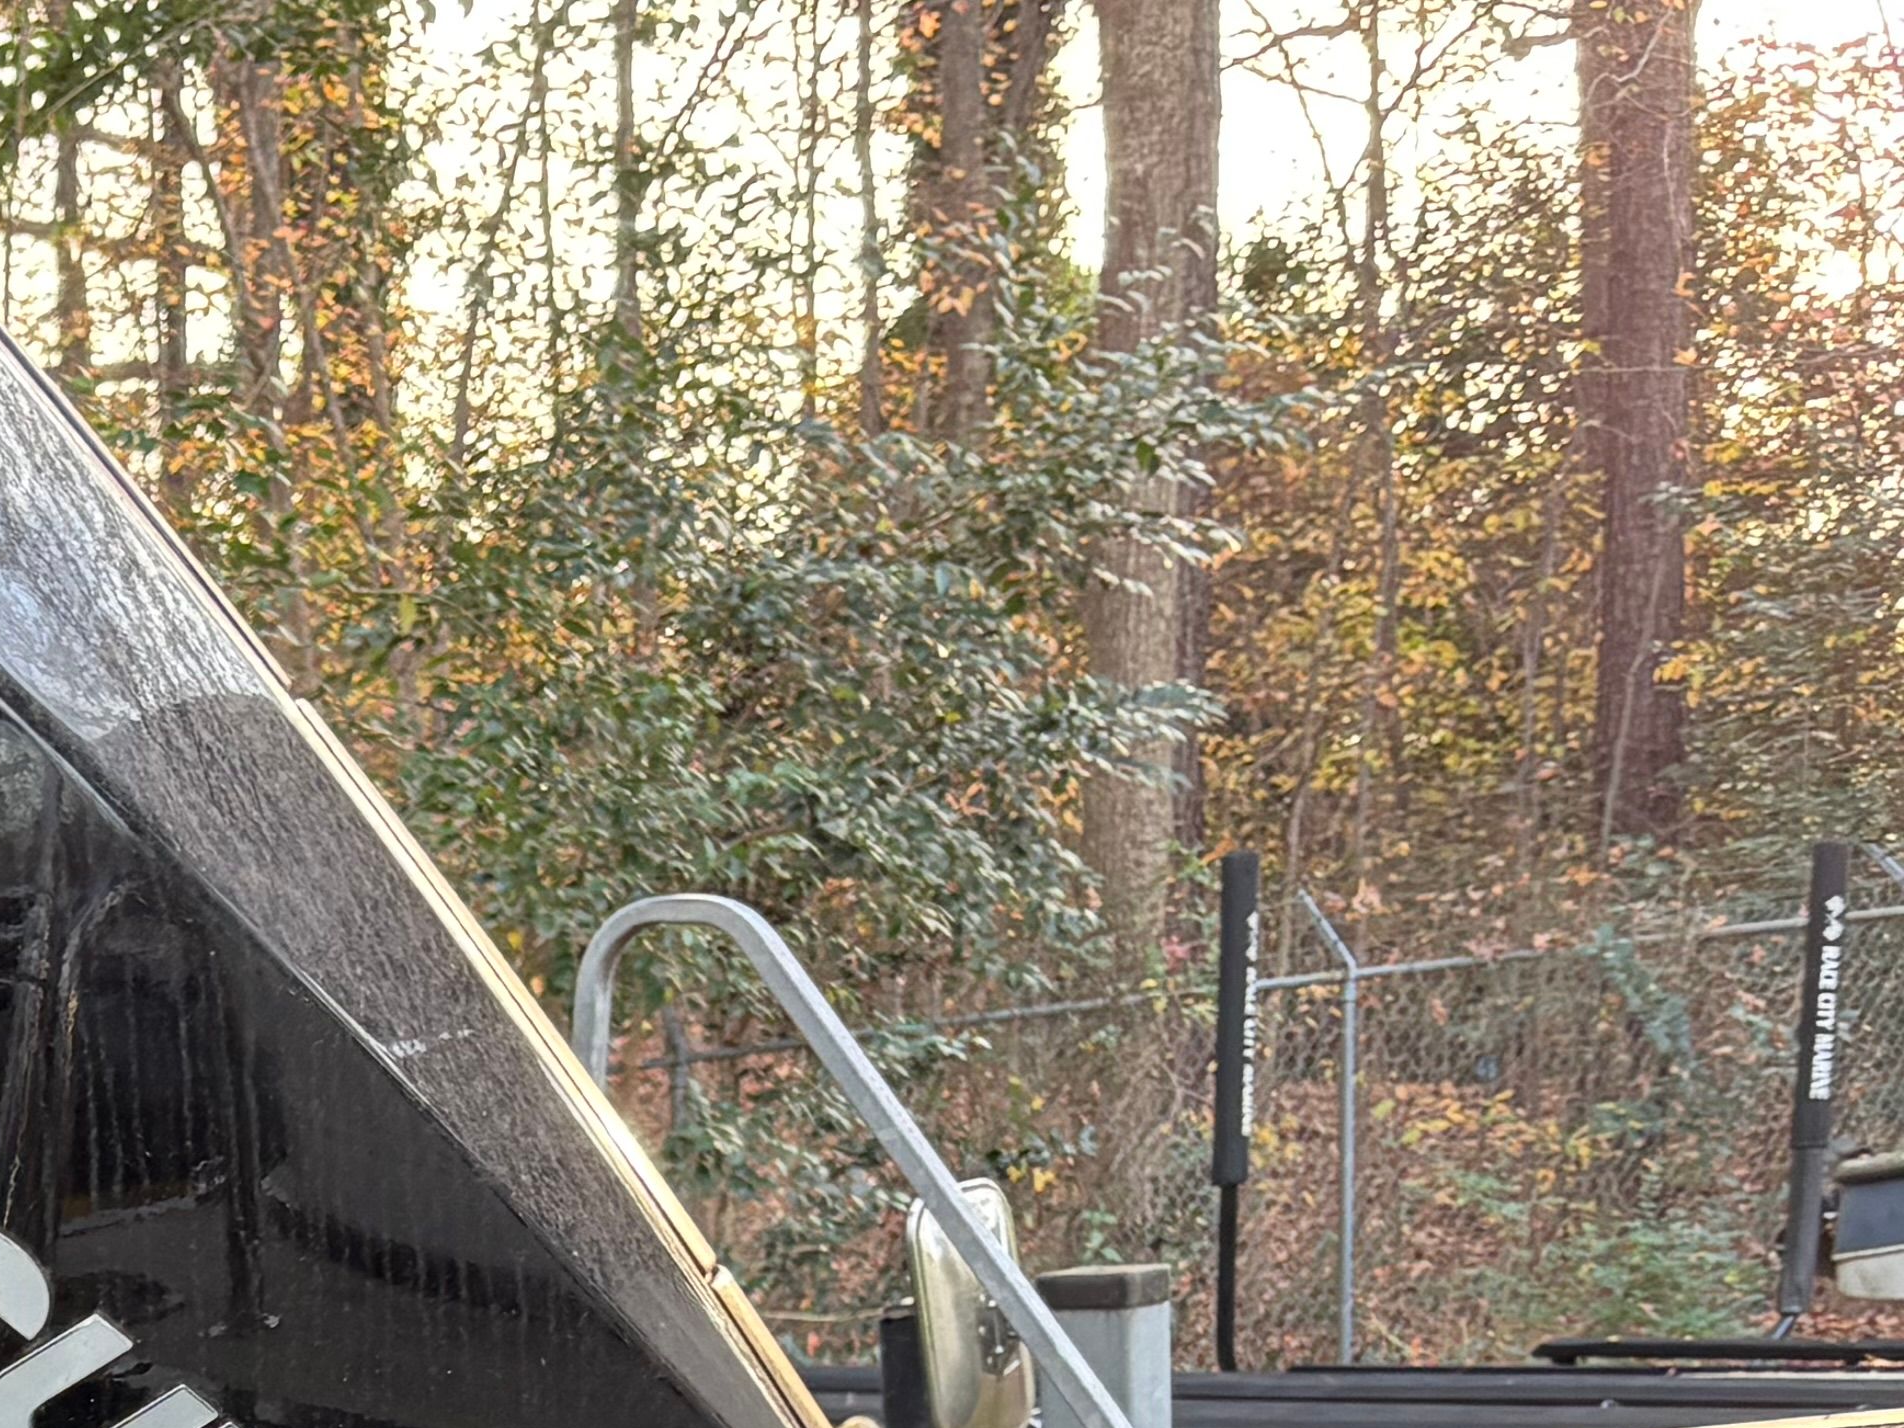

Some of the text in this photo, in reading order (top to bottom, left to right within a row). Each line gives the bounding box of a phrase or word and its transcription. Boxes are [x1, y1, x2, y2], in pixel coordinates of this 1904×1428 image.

[1808, 945, 1841, 1099] RACE CITY MARINE
